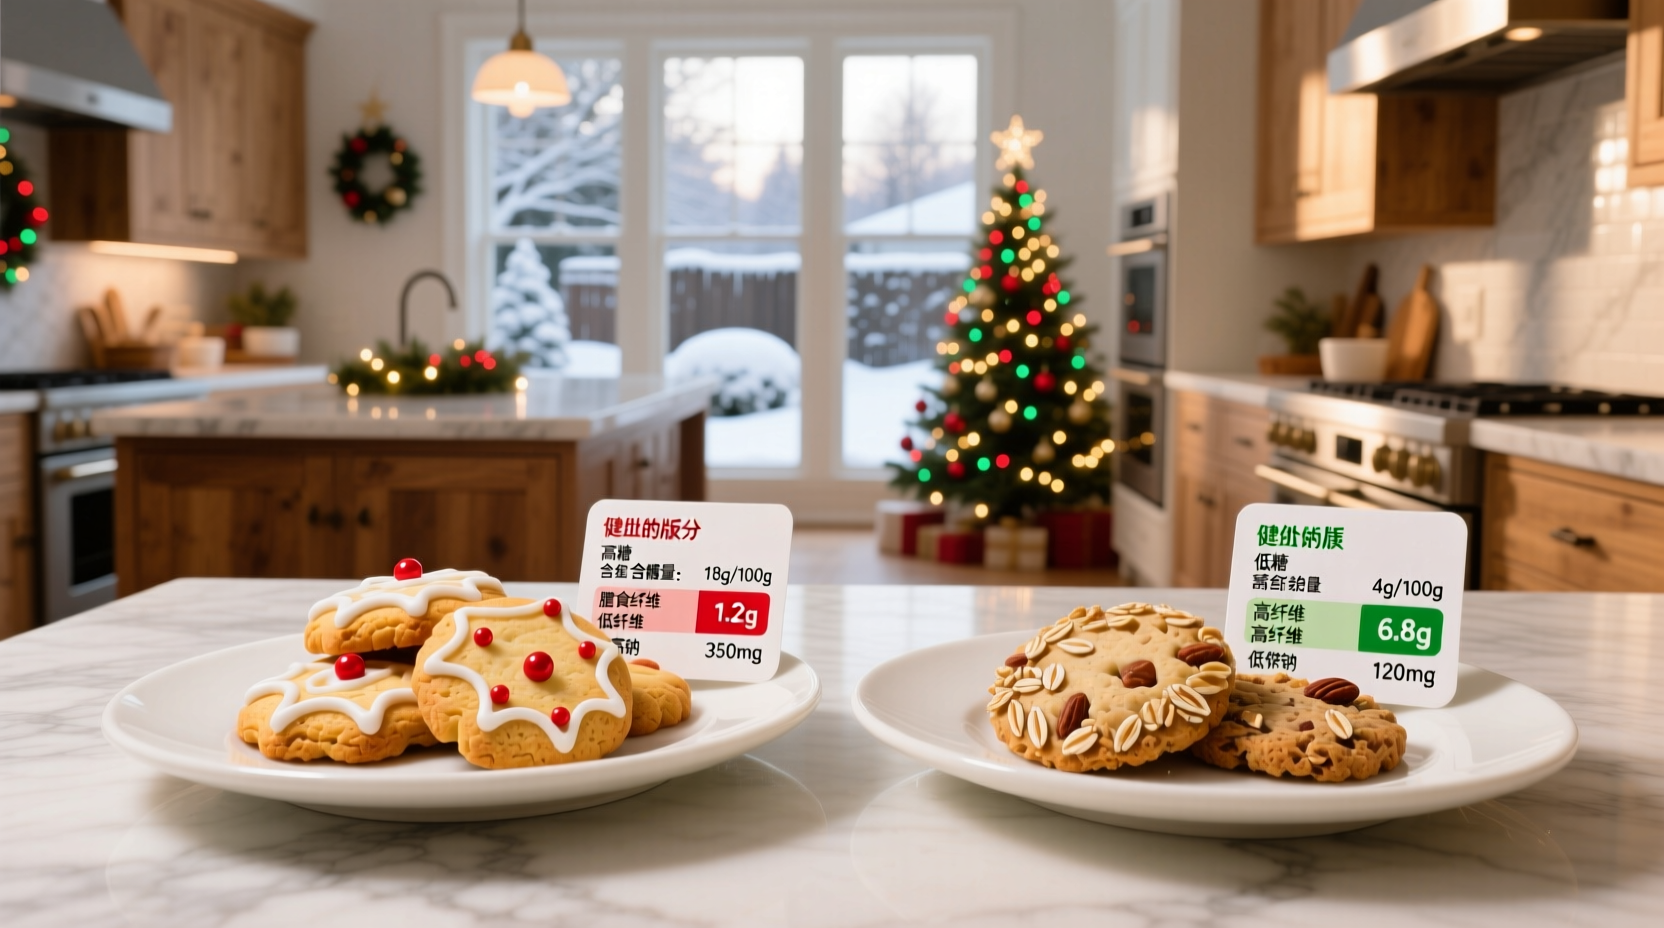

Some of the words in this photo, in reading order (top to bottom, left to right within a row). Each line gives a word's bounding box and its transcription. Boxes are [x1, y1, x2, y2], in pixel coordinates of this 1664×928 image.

[704, 566, 773, 586] 18g/100g
[1372, 578, 1443, 602] 4g/100g
[597, 612, 644, 630] 低纤维
[714, 602, 758, 629] 1.2g
[1253, 602, 1305, 622] 高纤维
[1250, 625, 1303, 645] 高纤维
[1377, 617, 1432, 649] 6.8g
[704, 642, 762, 664] 350mg
[1373, 662, 1436, 687] 120mg
